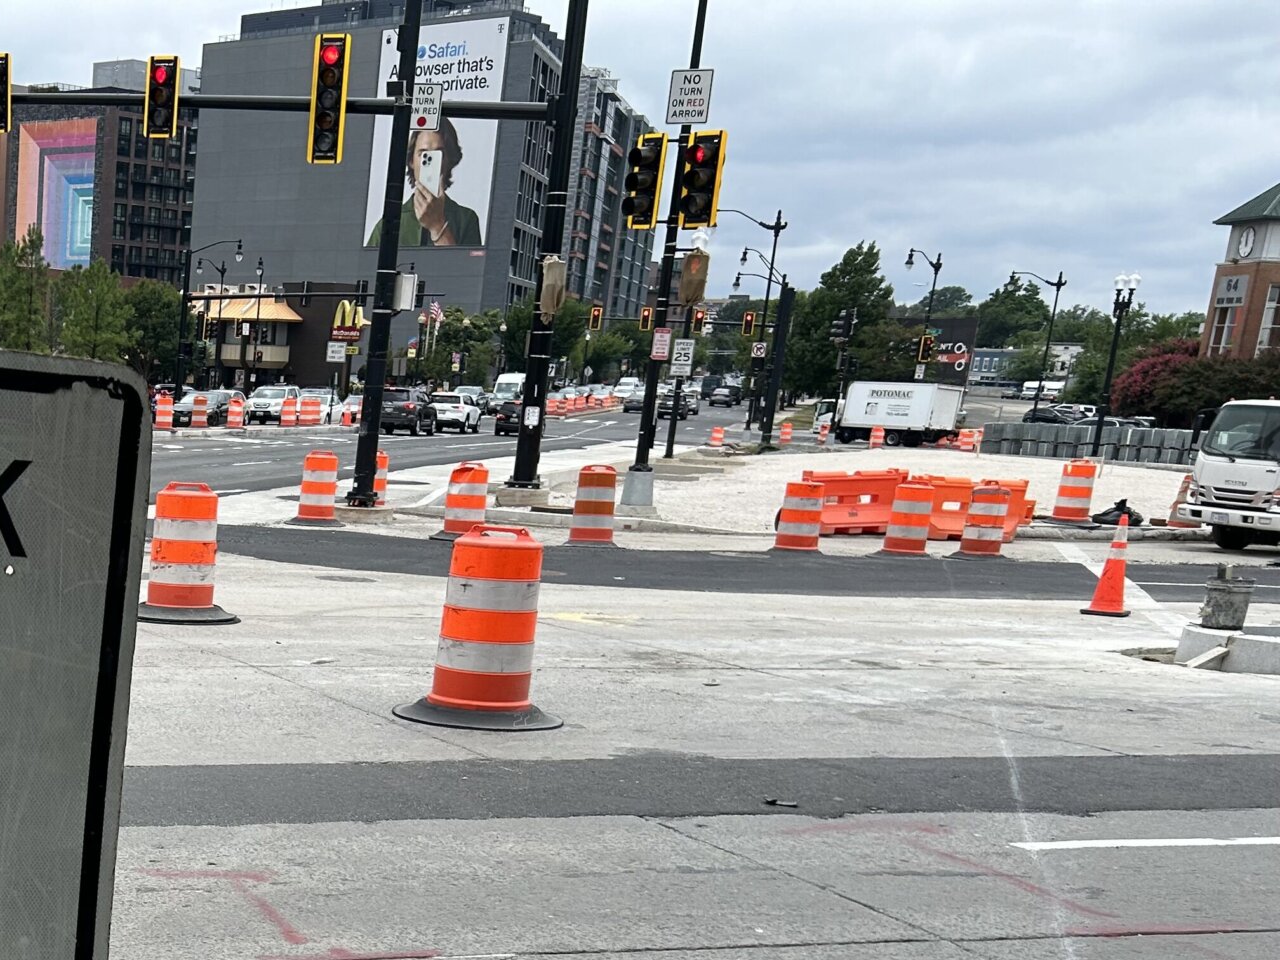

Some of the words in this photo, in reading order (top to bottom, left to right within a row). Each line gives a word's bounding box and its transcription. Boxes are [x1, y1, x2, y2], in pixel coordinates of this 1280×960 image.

[428, 40, 468, 59] Safari.
[415, 62, 455, 77] owser
[457, 56, 494, 74] that's
[442, 74, 489, 91] private.
[683, 74, 701, 85] NO
[418, 86, 433, 96] NO
[679, 87, 703, 96] TURN
[415, 97, 435, 105] TURN
[671, 98, 684, 107] ON
[686, 98, 705, 107] RED
[422, 107, 438, 115] RED
[670, 109, 704, 118] ARROW
[1226, 279, 1239, 292] 64
[674, 352, 690, 362] 25
[871, 389, 913, 398] POTOMAC
